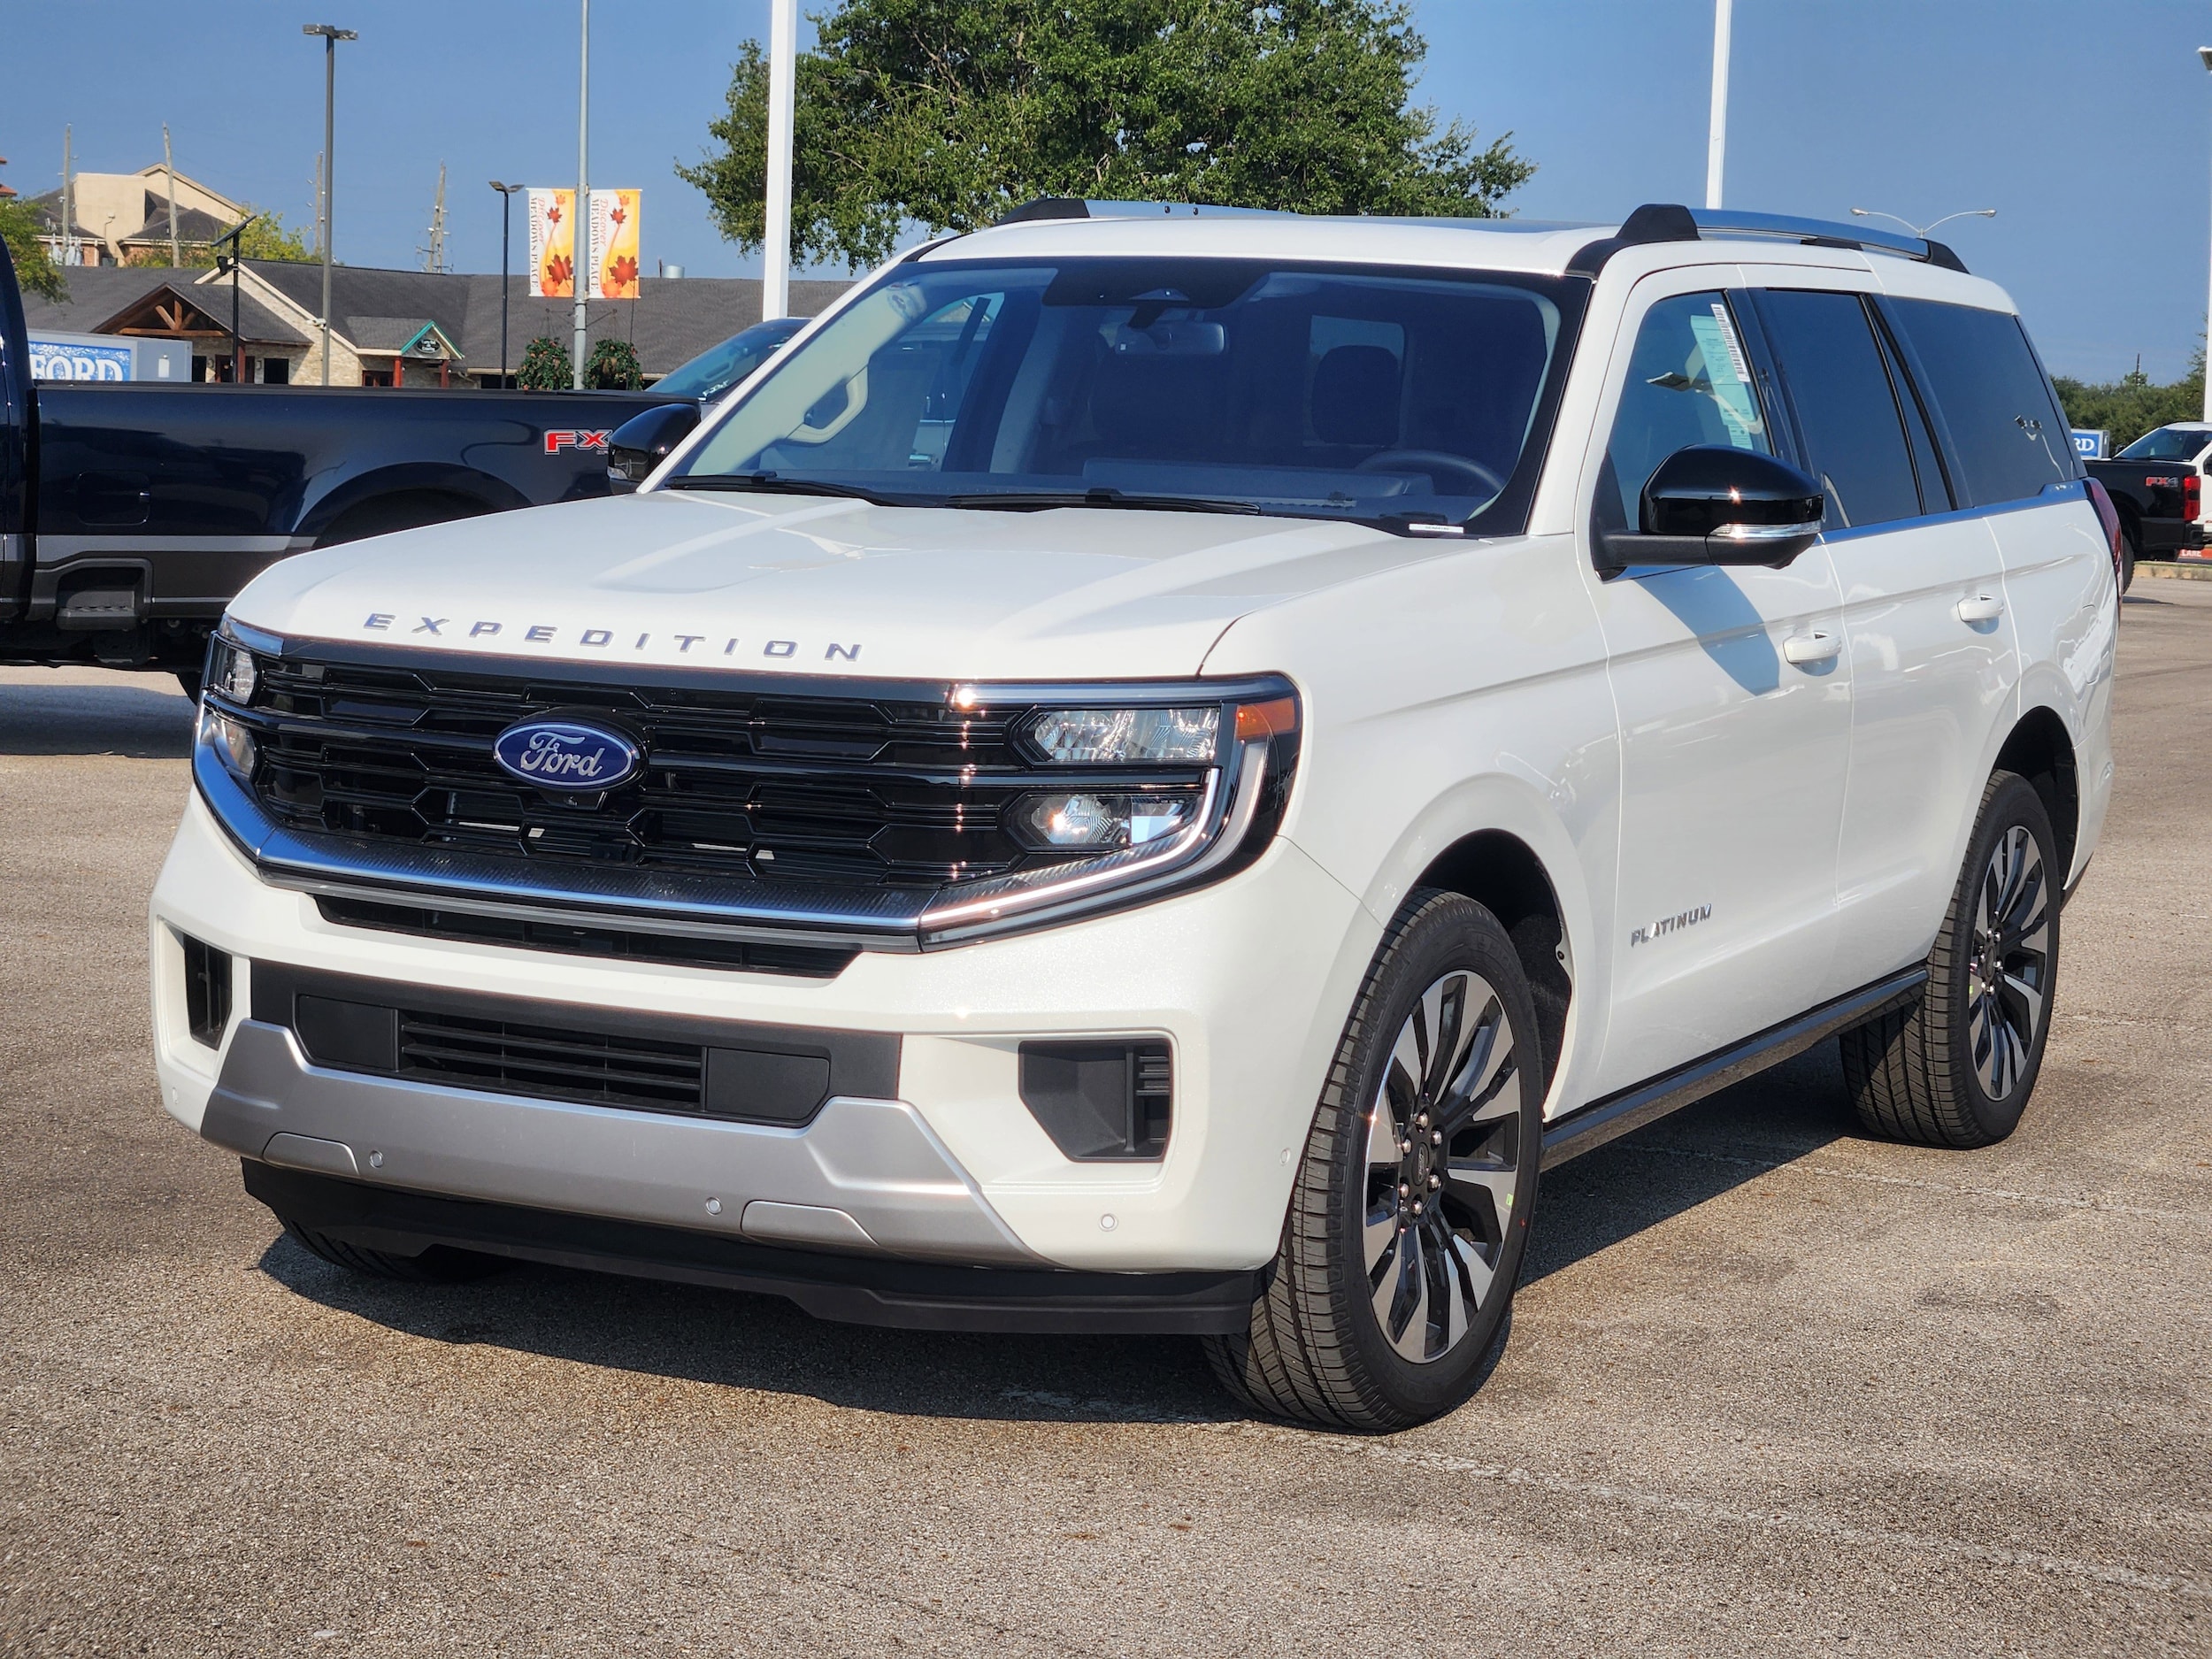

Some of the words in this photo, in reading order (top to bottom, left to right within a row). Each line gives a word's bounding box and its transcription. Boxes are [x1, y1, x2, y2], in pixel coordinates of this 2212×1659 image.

[591, 199, 600, 253] MEADOWS
[591, 256, 600, 290] PLACE
[29, 354, 124, 381] FORD
[544, 429, 613, 455] FX
[2146, 476, 2178, 488] FX4
[363, 612, 862, 662] EXPEDITION
[520, 732, 605, 777] Ford
[1631, 902, 1711, 948] PLATINUM
